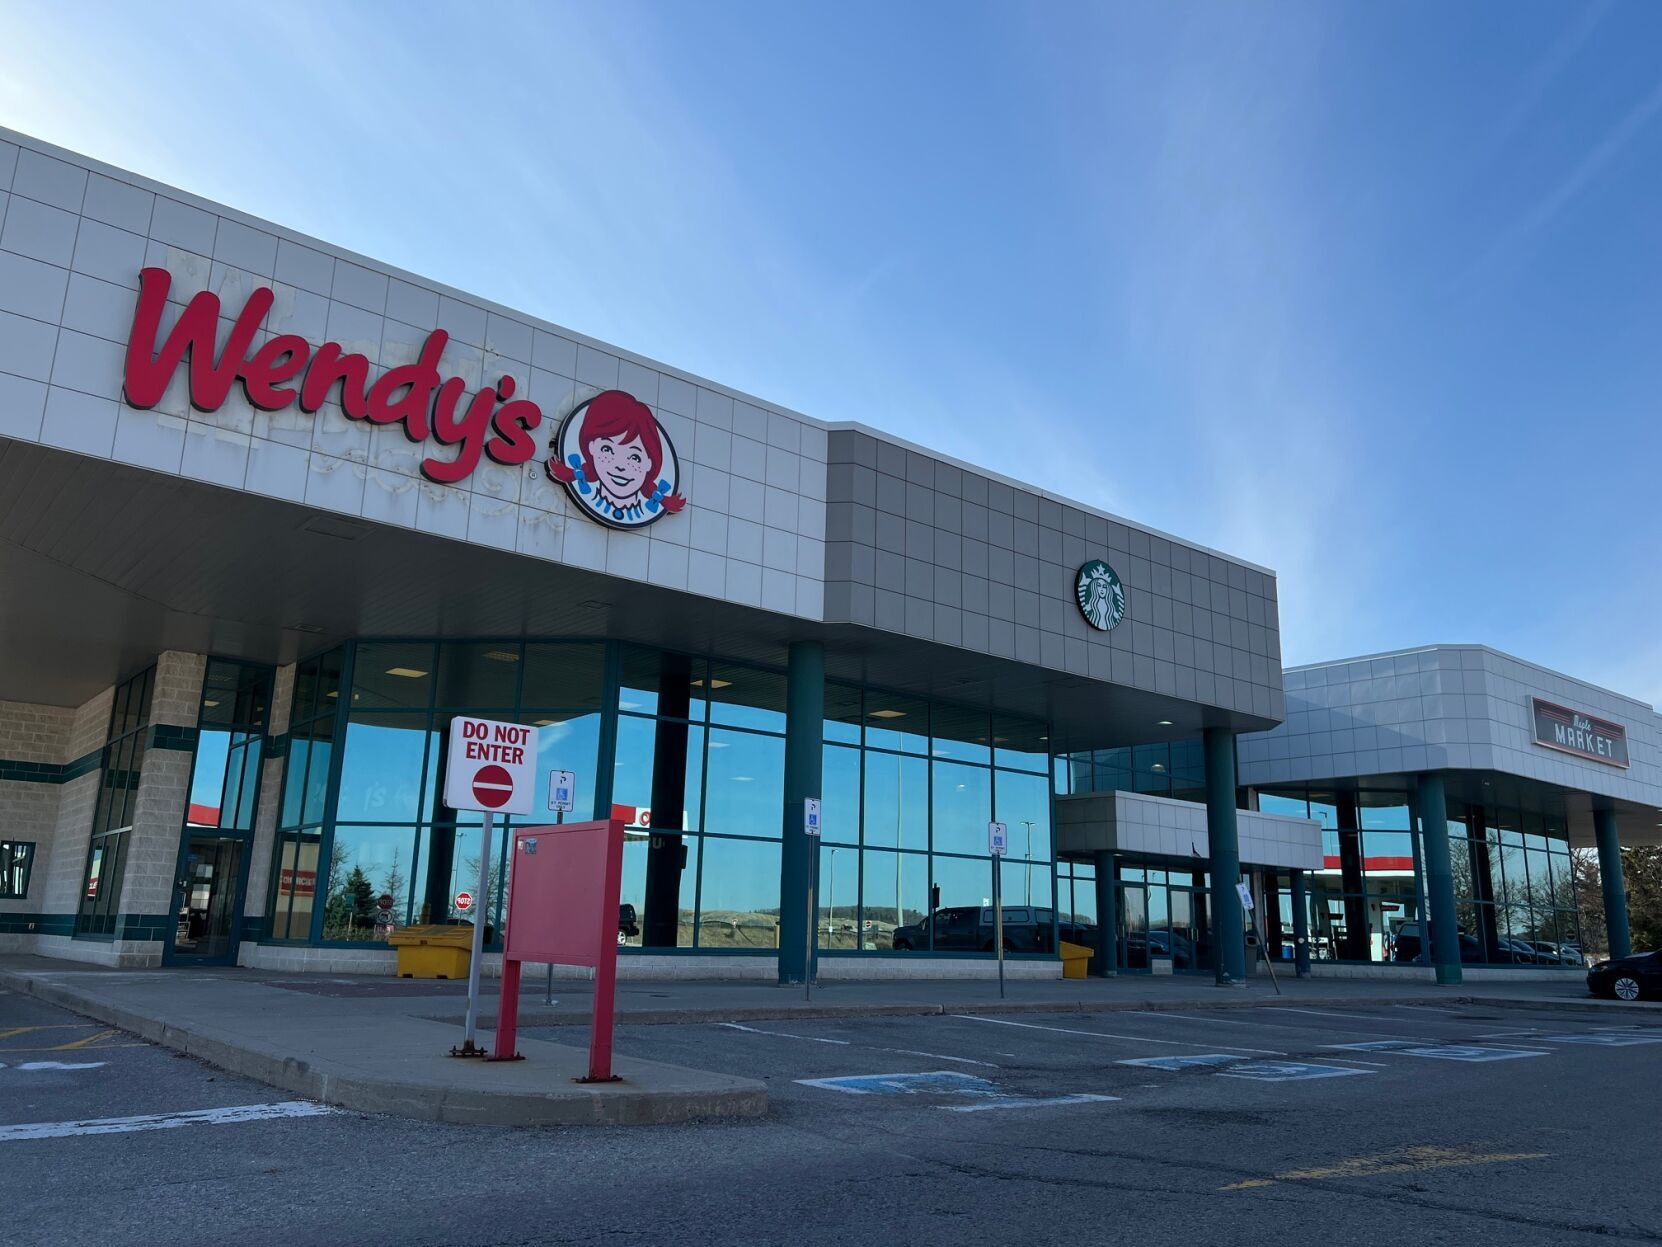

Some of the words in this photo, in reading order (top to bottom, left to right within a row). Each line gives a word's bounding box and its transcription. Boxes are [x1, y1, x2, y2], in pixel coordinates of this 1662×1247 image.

[123, 267, 542, 484] Wendy's
[463, 720, 489, 741] DO
[494, 725, 531, 746] NOT
[1554, 723, 1612, 758] MARKET
[465, 741, 524, 765] ENTER
